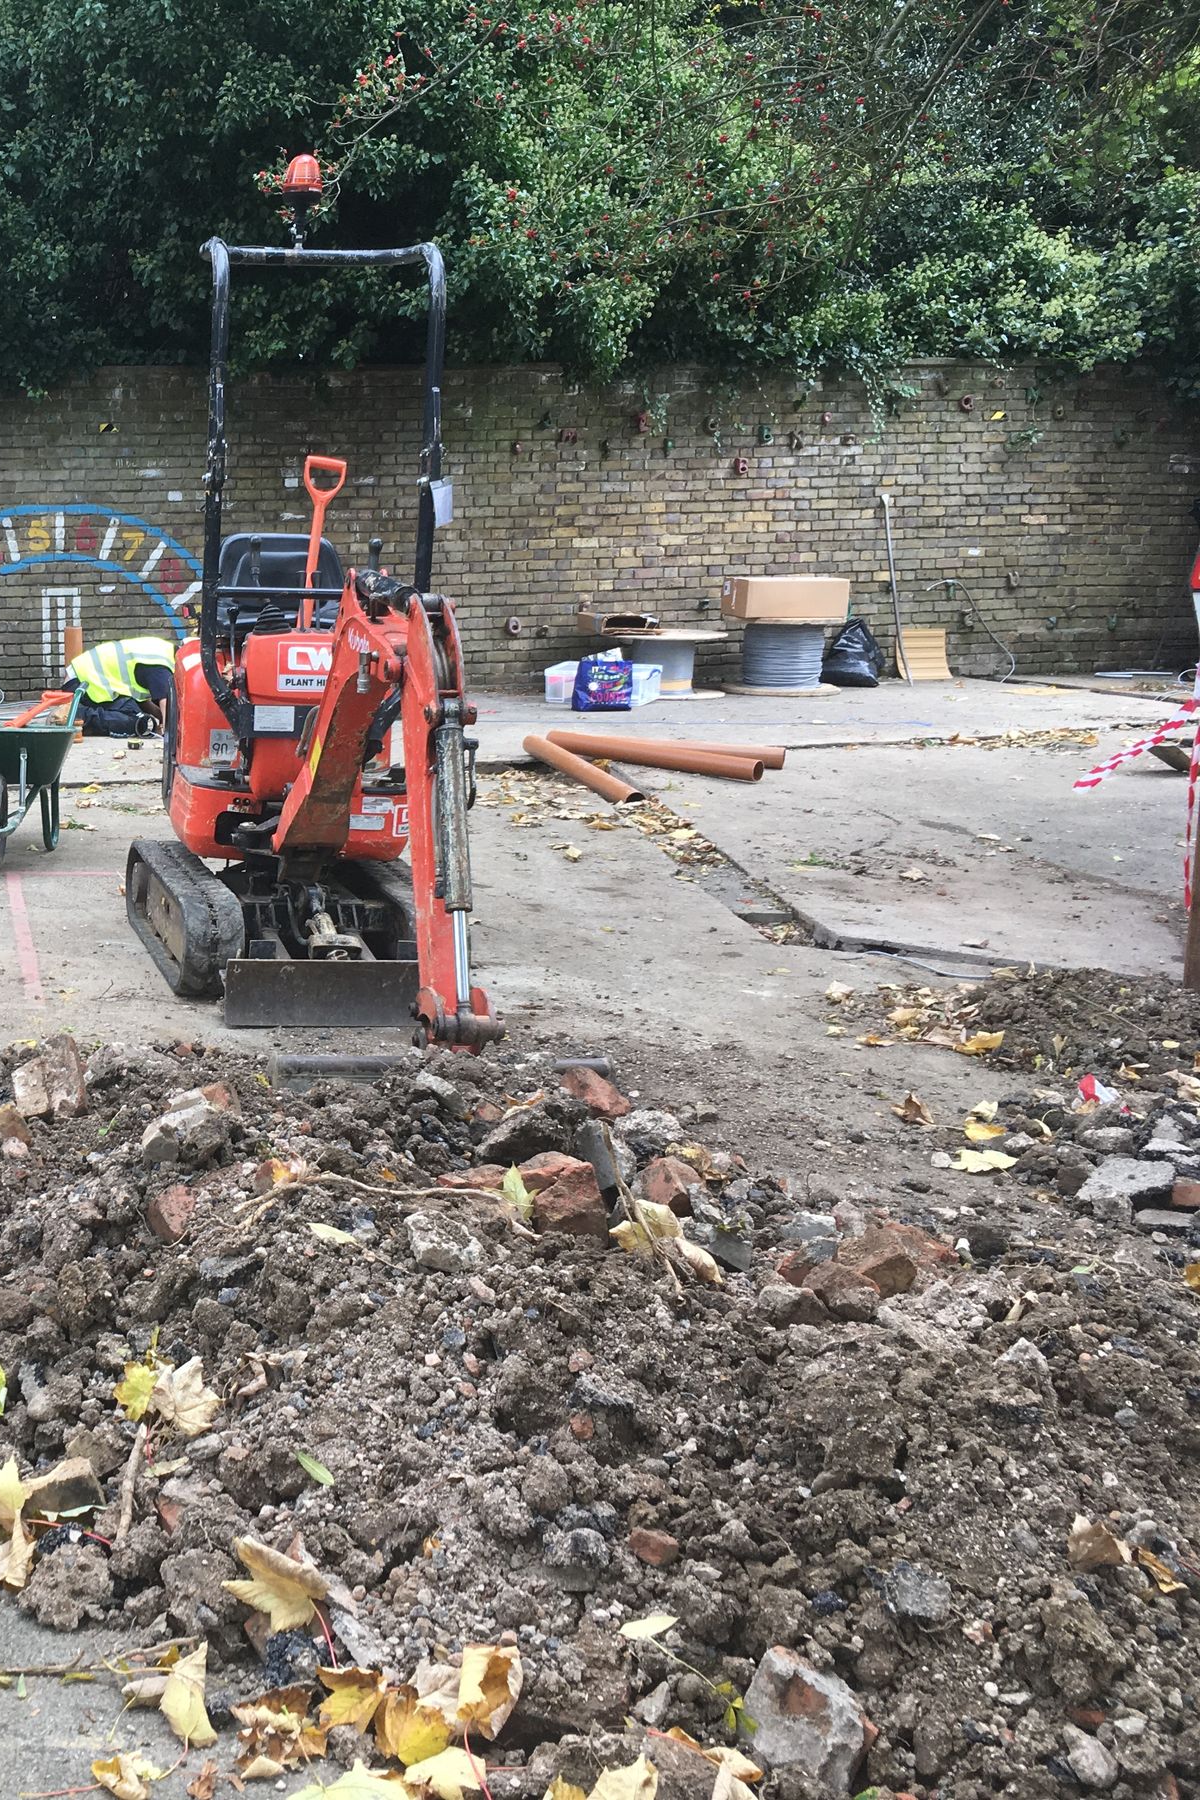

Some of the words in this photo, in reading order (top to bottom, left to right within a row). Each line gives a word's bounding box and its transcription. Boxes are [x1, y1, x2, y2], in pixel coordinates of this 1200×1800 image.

[27, 520, 51, 551] 5
[75, 516, 98, 550] 6
[122, 532, 145, 561] 7
[285, 678, 314, 686] PLANT
[316, 679, 326, 687] HI
